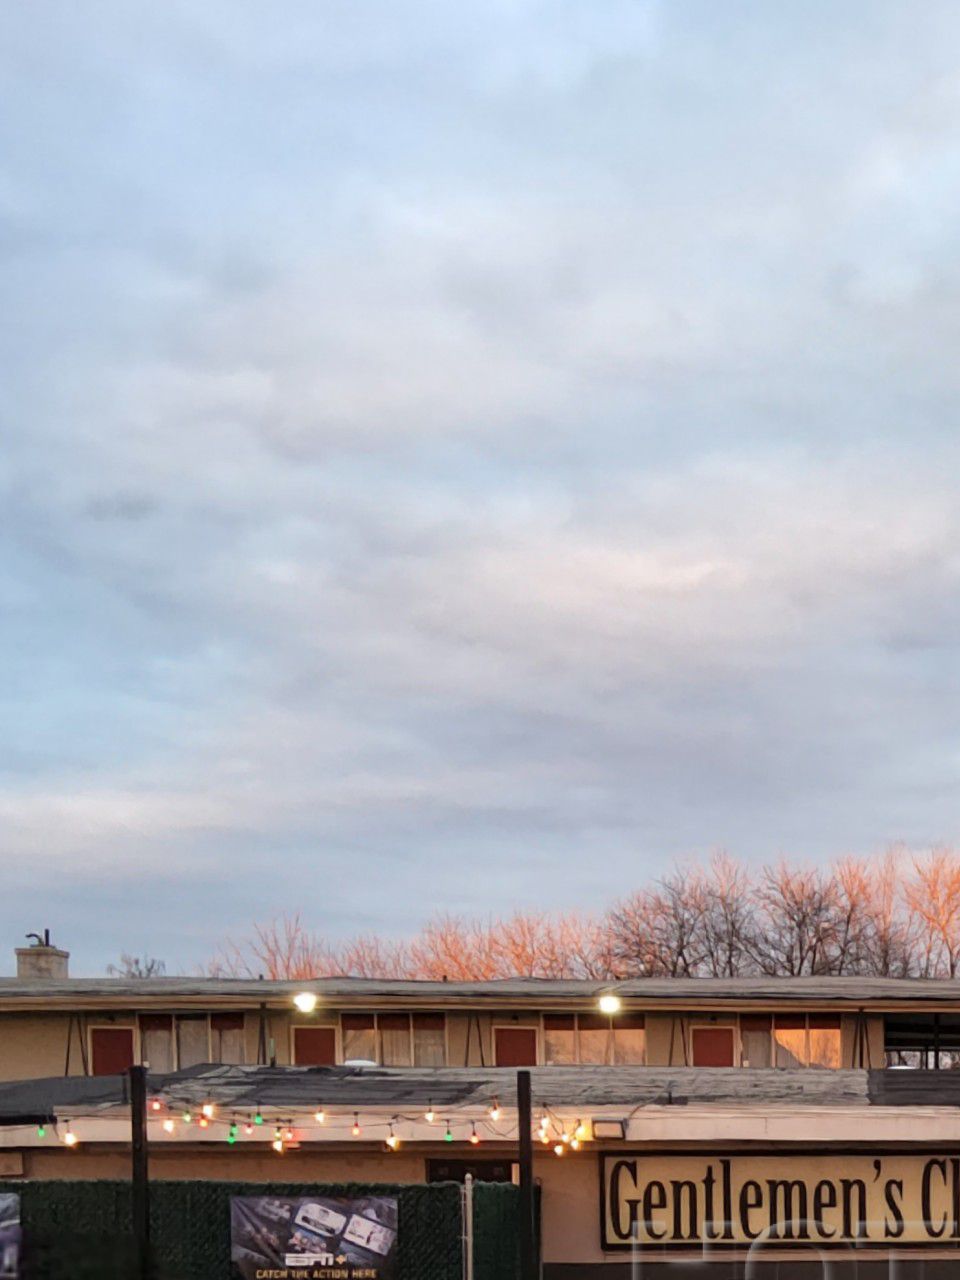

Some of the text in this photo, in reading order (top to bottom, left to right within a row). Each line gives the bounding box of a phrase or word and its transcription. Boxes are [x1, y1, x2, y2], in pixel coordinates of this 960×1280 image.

[610, 1158, 904, 1241] Gentlemen's
[256, 1269, 377, 1280] CATCH THE ACTION HERE
